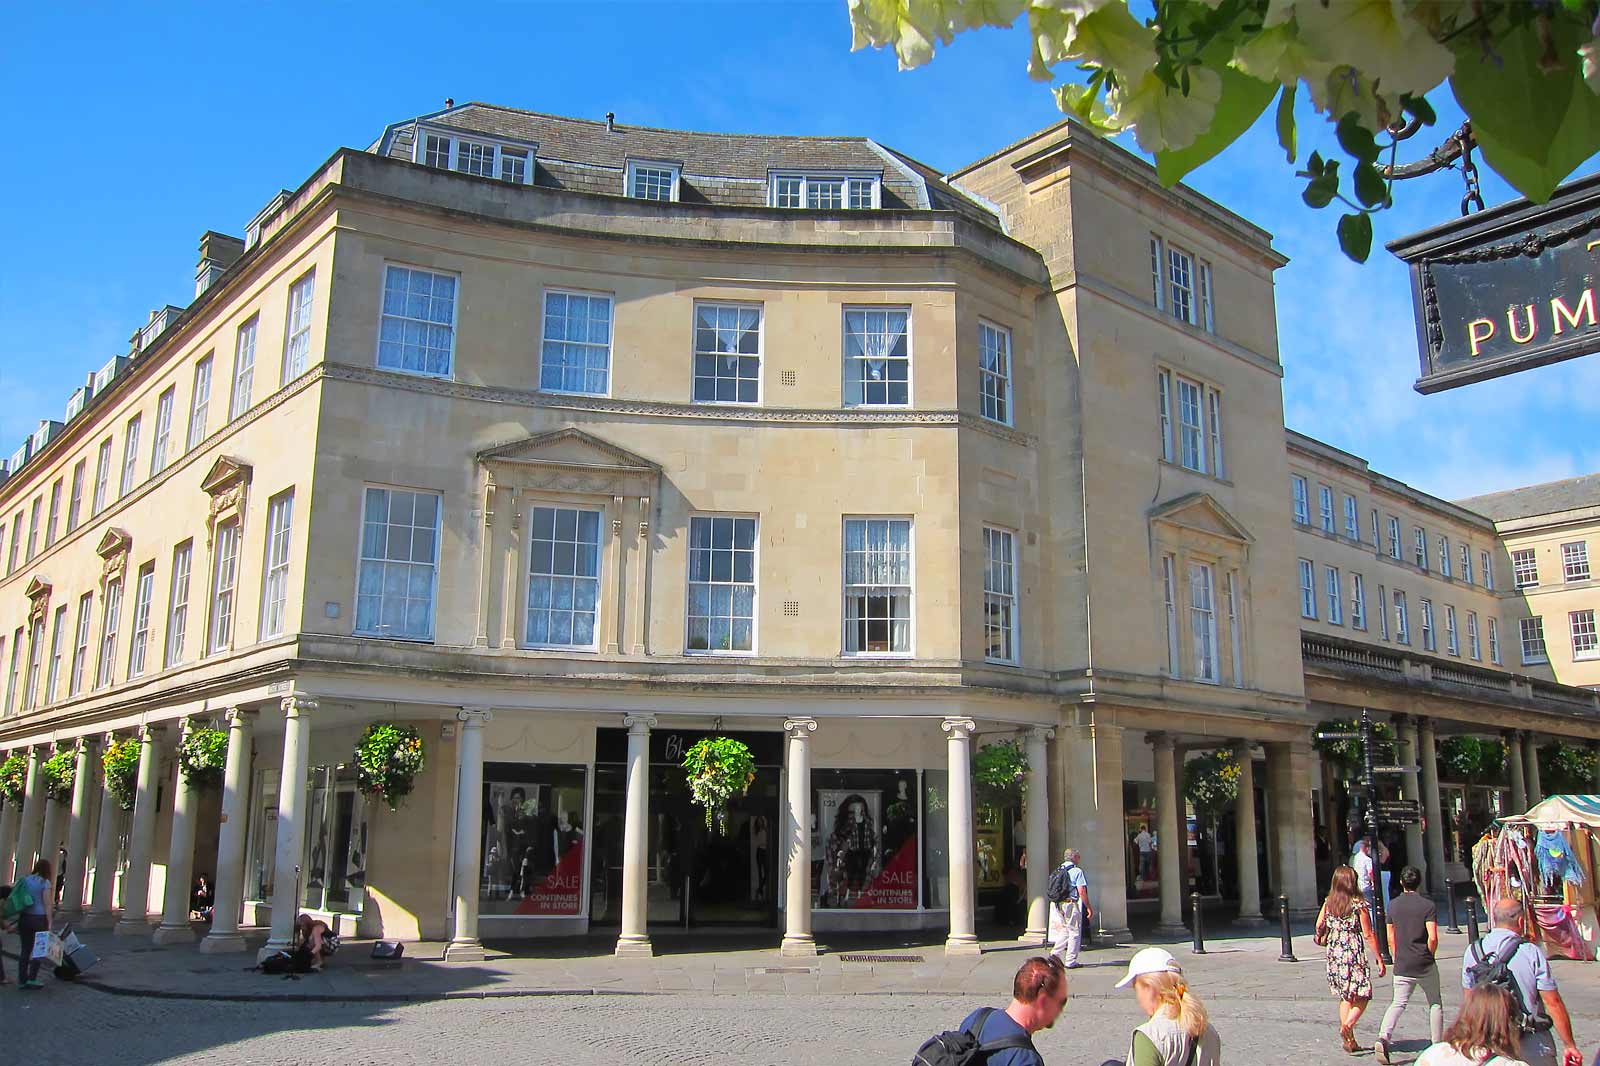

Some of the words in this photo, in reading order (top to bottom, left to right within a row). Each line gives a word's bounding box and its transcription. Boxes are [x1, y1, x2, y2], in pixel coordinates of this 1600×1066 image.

[1467, 288, 1599, 357] PUM
[546, 875, 579, 889] SALE
[882, 871, 913, 885] SALE
[867, 889, 913, 897] CONTINUES
[530, 894, 578, 902] CONTINUES
[877, 896, 887, 904] IN
[888, 896, 913, 904] STORE
[540, 902, 550, 910] IN
[552, 902, 578, 910] STORE
